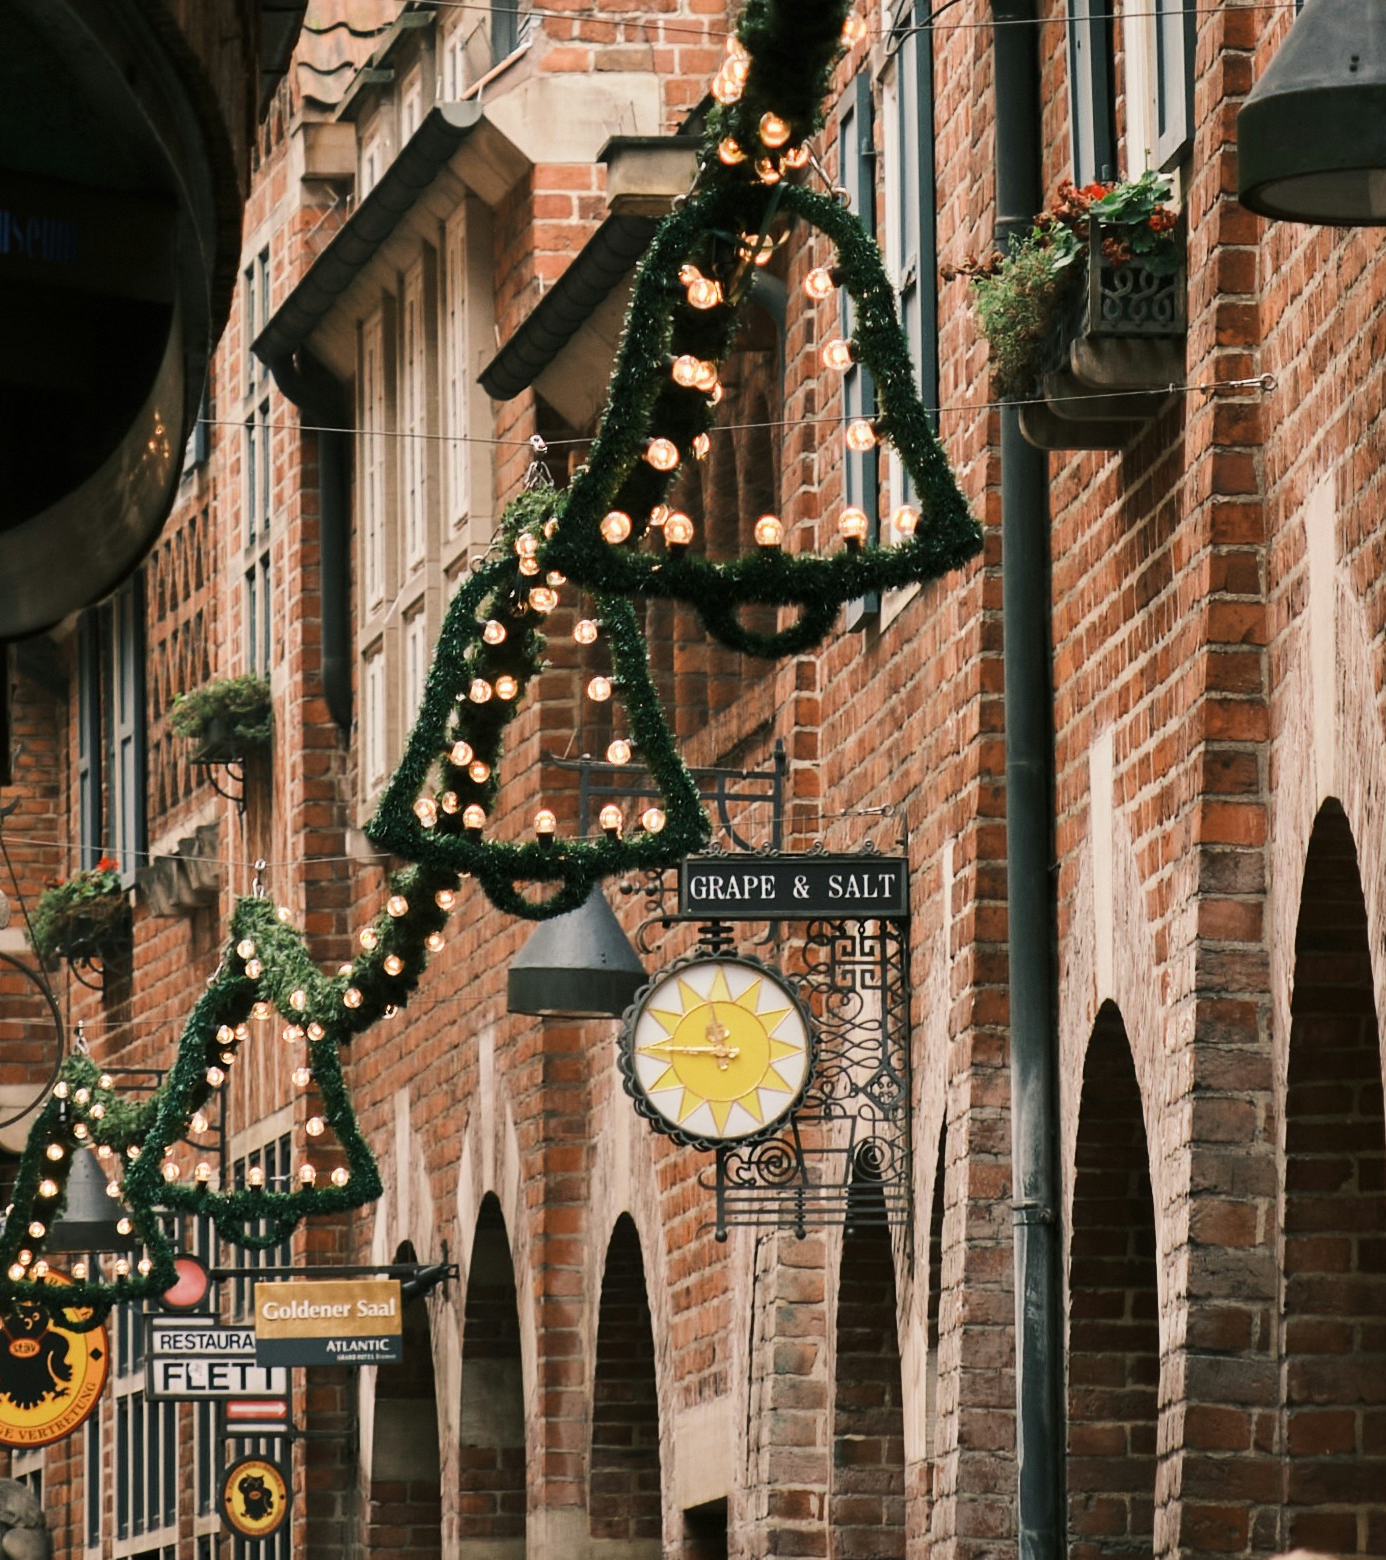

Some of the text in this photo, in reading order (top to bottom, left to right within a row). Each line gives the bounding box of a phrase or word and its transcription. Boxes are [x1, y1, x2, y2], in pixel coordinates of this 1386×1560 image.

[689, 873, 895, 900] GRAPE & SALT
[262, 1297, 396, 1321] Goldener Saal
[326, 1339, 390, 1352] ATLANTIC
[18, 1382, 96, 1440] VERTRETUNG
